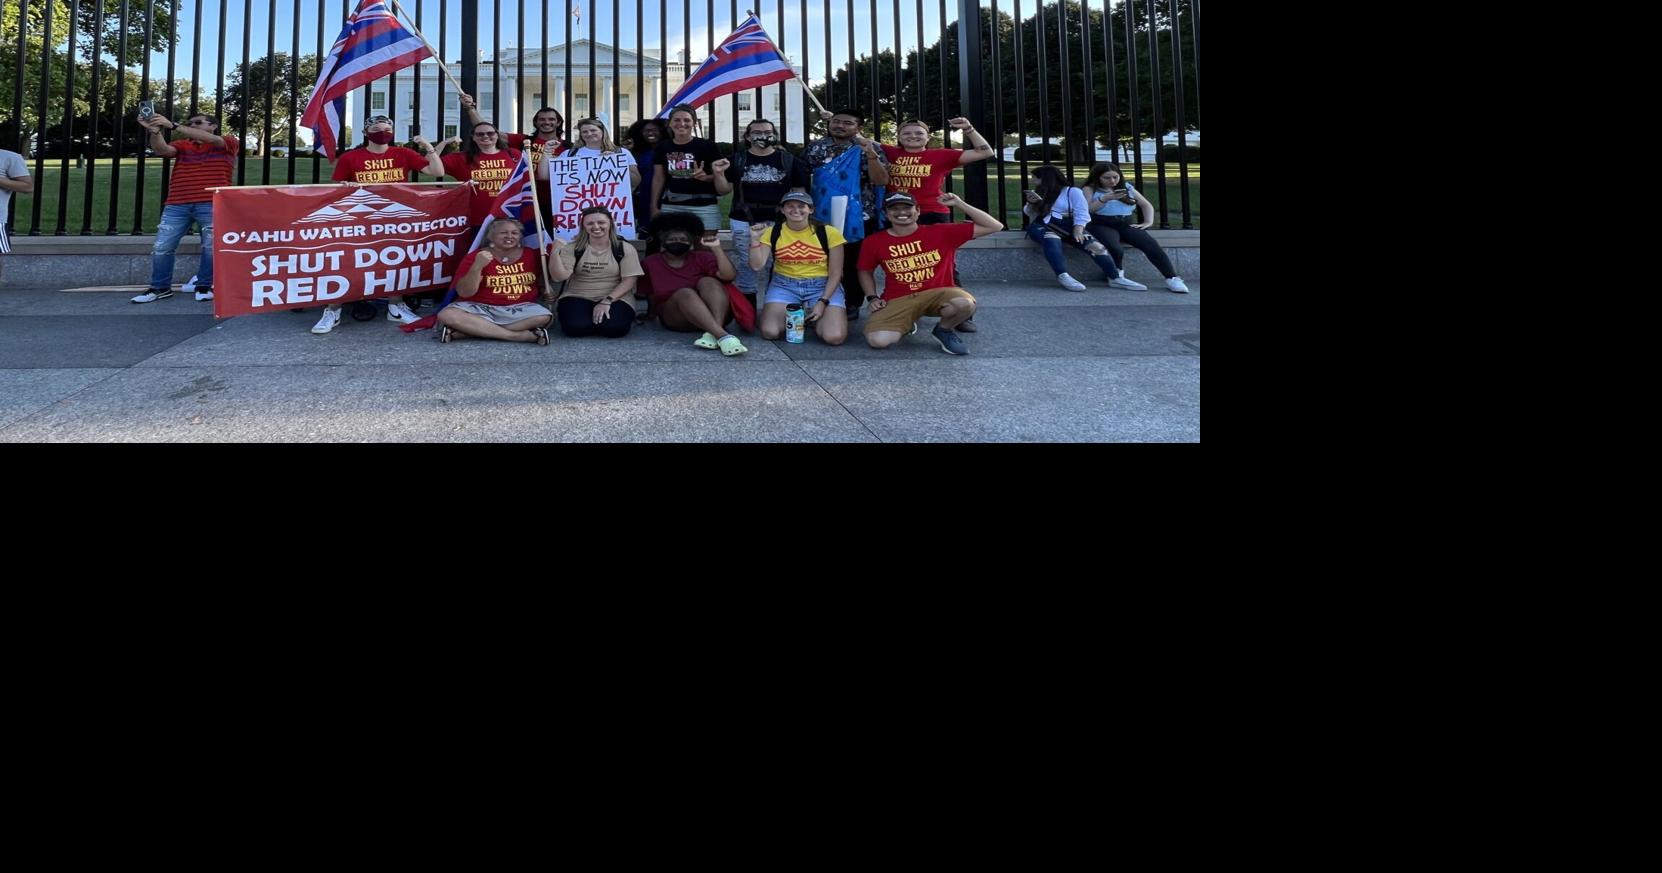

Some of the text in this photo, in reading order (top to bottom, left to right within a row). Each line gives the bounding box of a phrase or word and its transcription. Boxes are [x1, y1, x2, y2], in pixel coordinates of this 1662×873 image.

[364, 158, 394, 170] SHUT
[479, 160, 506, 169] SHUT
[550, 159, 578, 172] THE
[580, 154, 627, 170] TIME
[905, 165, 928, 174] HILL
[357, 170, 402, 182] RED HILL
[473, 170, 493, 179] RED
[556, 168, 627, 185] IS NOW
[565, 182, 620, 199] SHUT
[300, 225, 366, 240] WATER
[371, 215, 467, 237] PROTECTOR
[888, 240, 922, 257] SHUT
[251, 239, 455, 277] SHUT DOWN
[887, 253, 939, 271] RED HILL
[495, 262, 525, 274] SHUT
[896, 267, 935, 282] DOWN
[251, 262, 453, 308] RED HILL
[489, 276, 512, 286] RED
